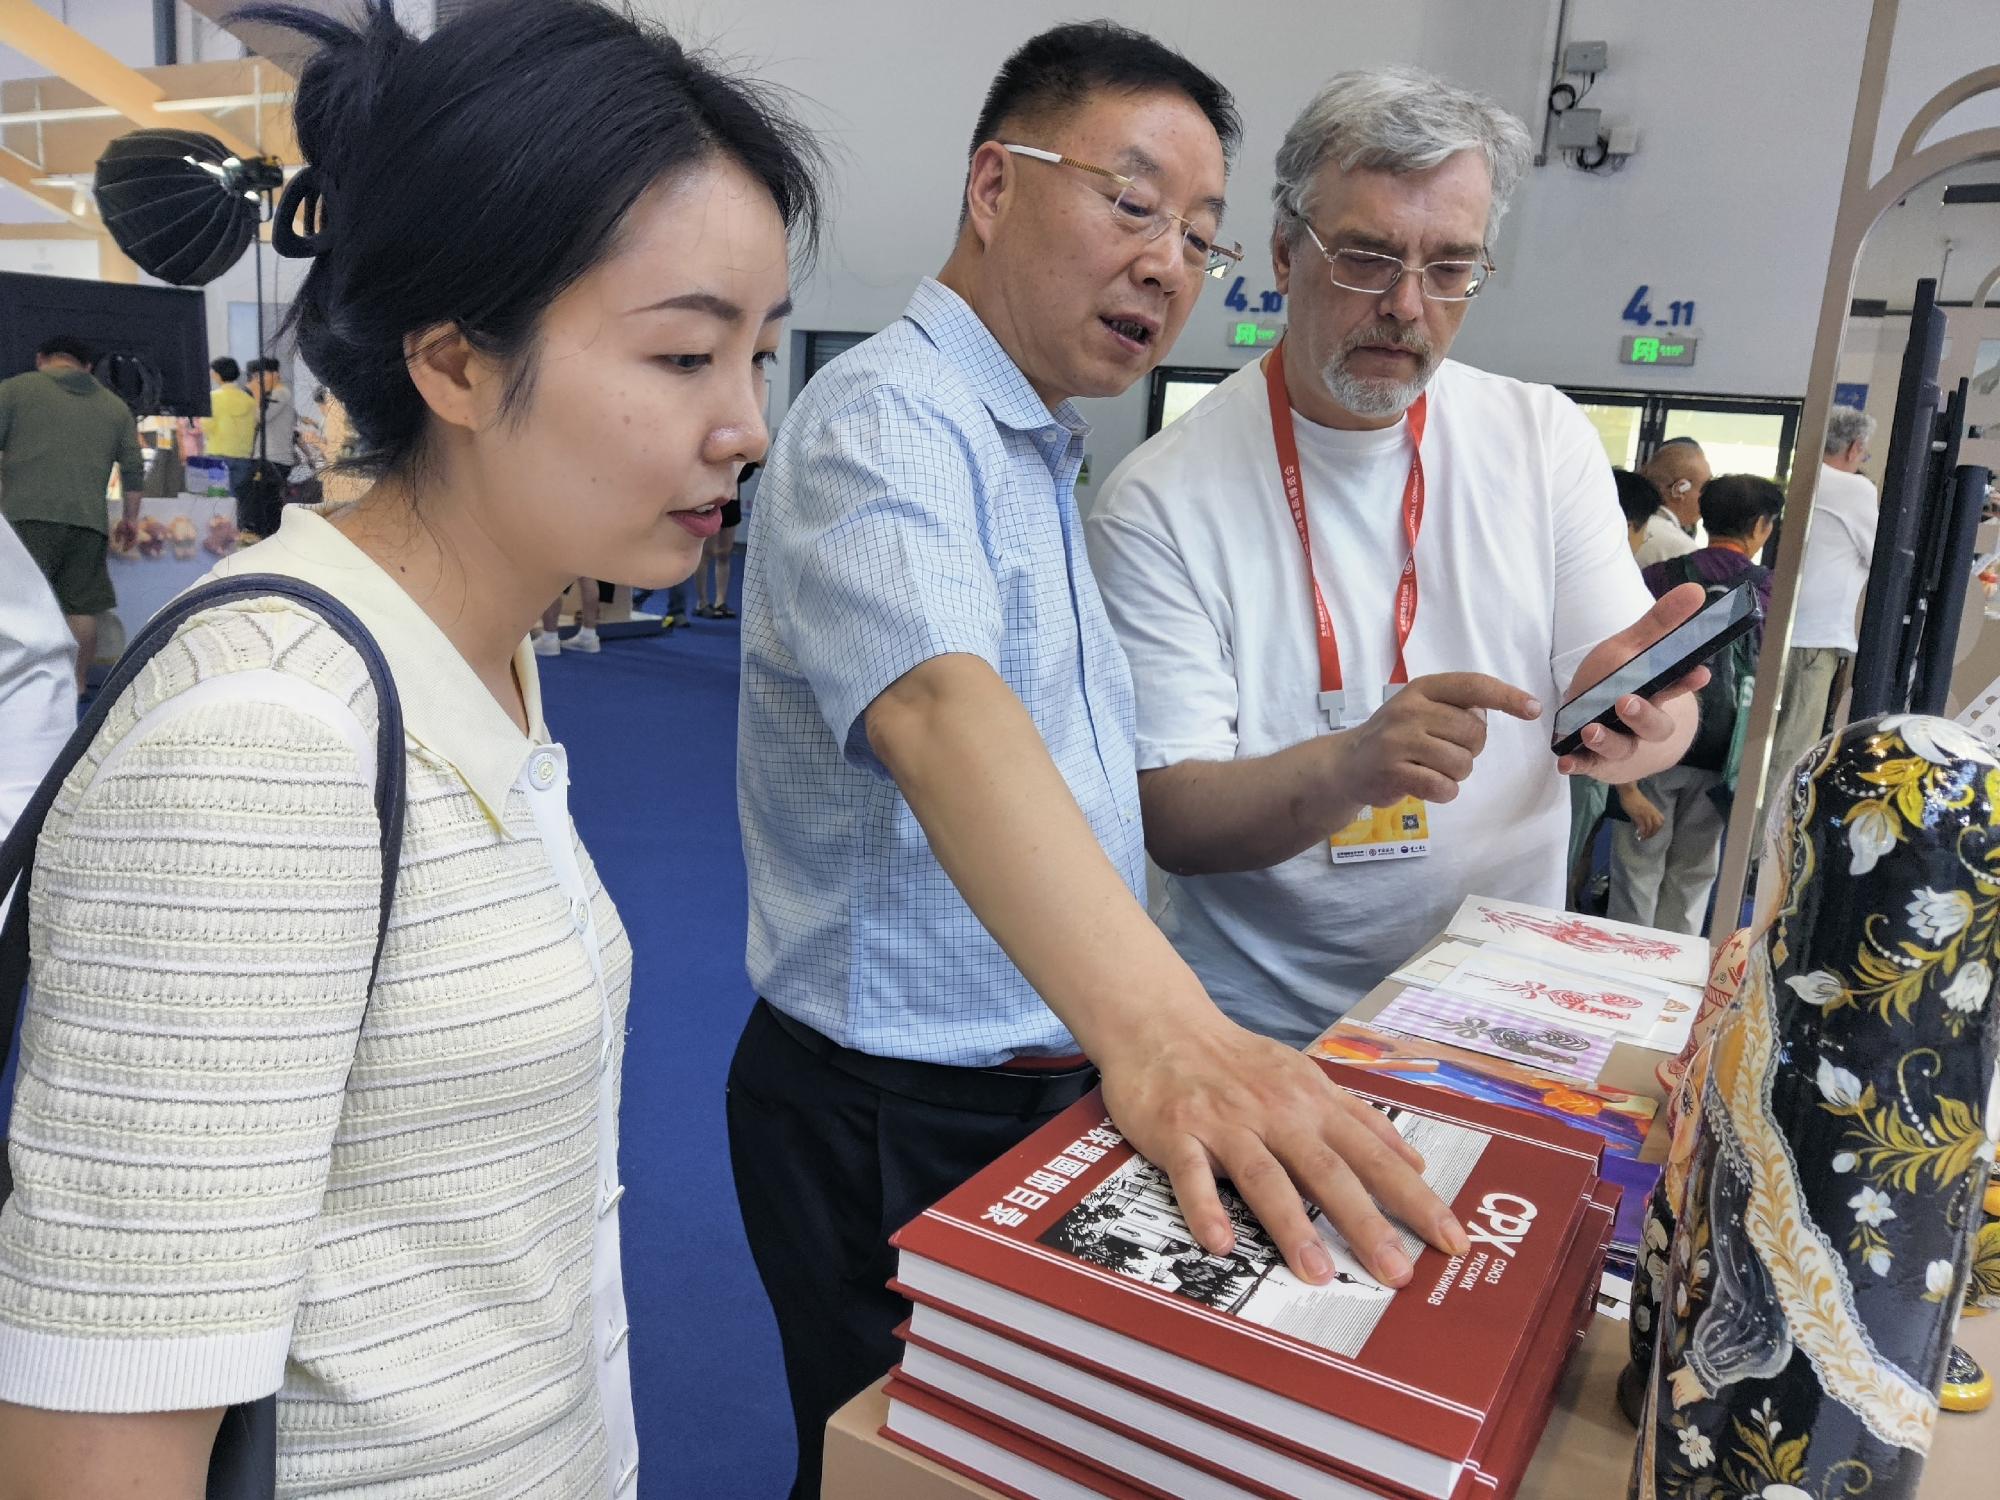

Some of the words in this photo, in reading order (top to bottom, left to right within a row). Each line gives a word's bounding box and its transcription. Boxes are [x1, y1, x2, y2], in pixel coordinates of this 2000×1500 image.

[980, 1117, 1124, 1228] 联盟画册目录
[1427, 1249, 1471, 1306] ДОЖНИКОВ
[1458, 1252, 1489, 1291] РУССКИХ
[1484, 1258, 1508, 1285] СОЮЗ
